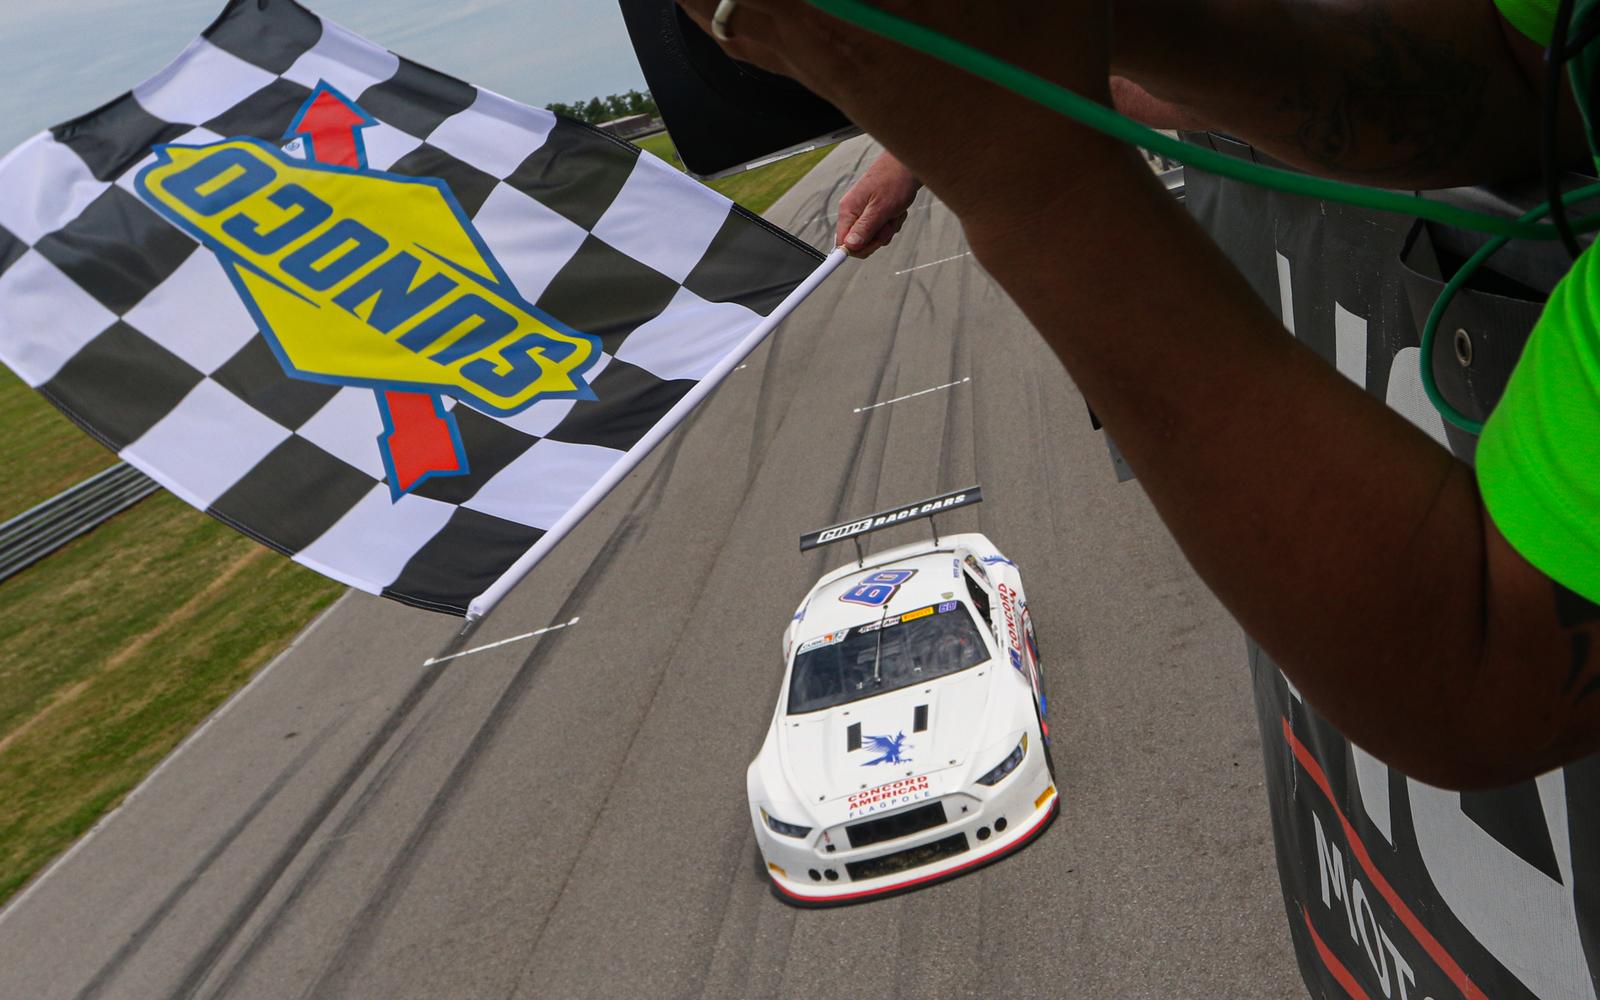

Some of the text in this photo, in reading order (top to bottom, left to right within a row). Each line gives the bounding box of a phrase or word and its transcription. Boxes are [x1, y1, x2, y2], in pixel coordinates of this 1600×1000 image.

[160, 147, 578, 398] SUNOCO
[820, 494, 966, 542] COPE RACE CARS
[839, 568, 919, 607] 60
[998, 583, 1021, 651] CONCORD
[848, 775, 928, 803] CONCORD
[849, 782, 929, 810] AMERICAN
[849, 791, 929, 817] FLAGPOLE
